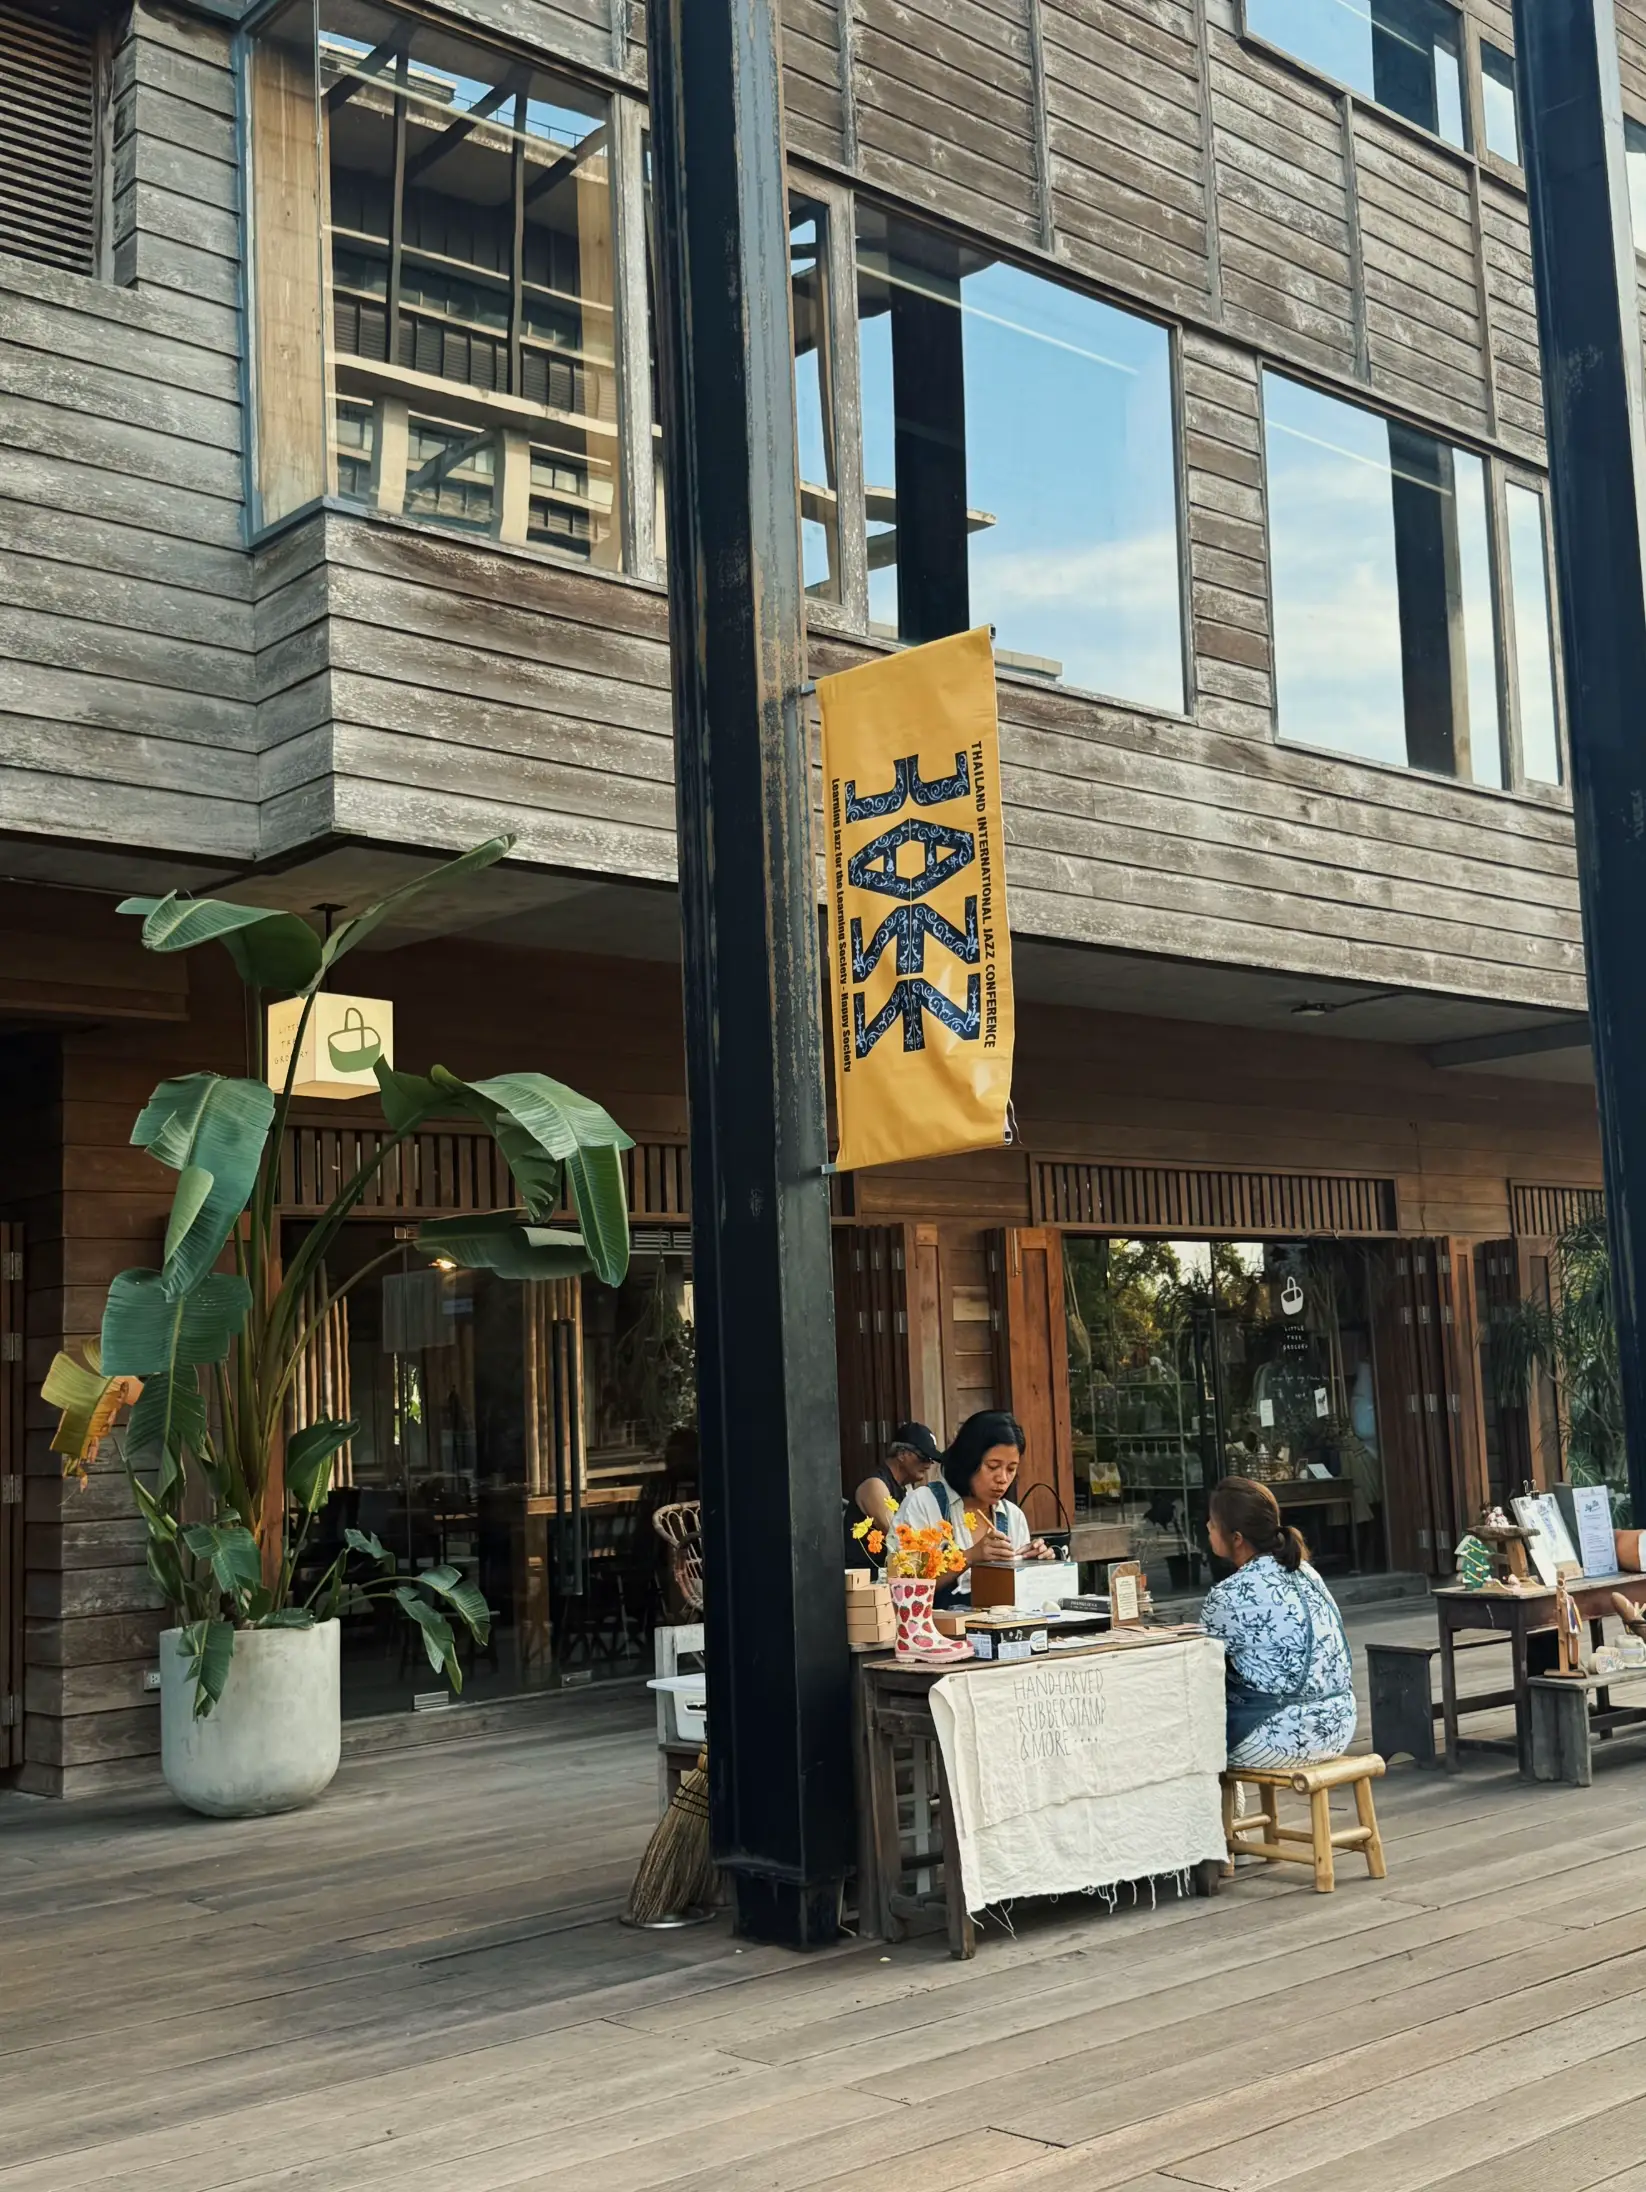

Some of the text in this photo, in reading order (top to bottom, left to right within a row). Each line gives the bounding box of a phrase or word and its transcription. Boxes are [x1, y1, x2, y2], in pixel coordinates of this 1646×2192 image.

[832, 778, 841, 828] Learning
[834, 829, 842, 852] Jazz
[835, 852, 843, 869] for
[836, 870, 844, 890] the
[907, 750, 981, 1050] JAZZ
[971, 741, 997, 1049] THAILAND INTERNATIONAL JAZZ CONFERENCE
[836, 890, 846, 941] Learning
[838, 941, 847, 984] Society
[841, 992, 849, 1028] Happy
[274, 1050, 308, 1065] GRORY
[842, 1028, 851, 1073] Society
[1013, 1668, 1104, 1700] HAND-CARVED
